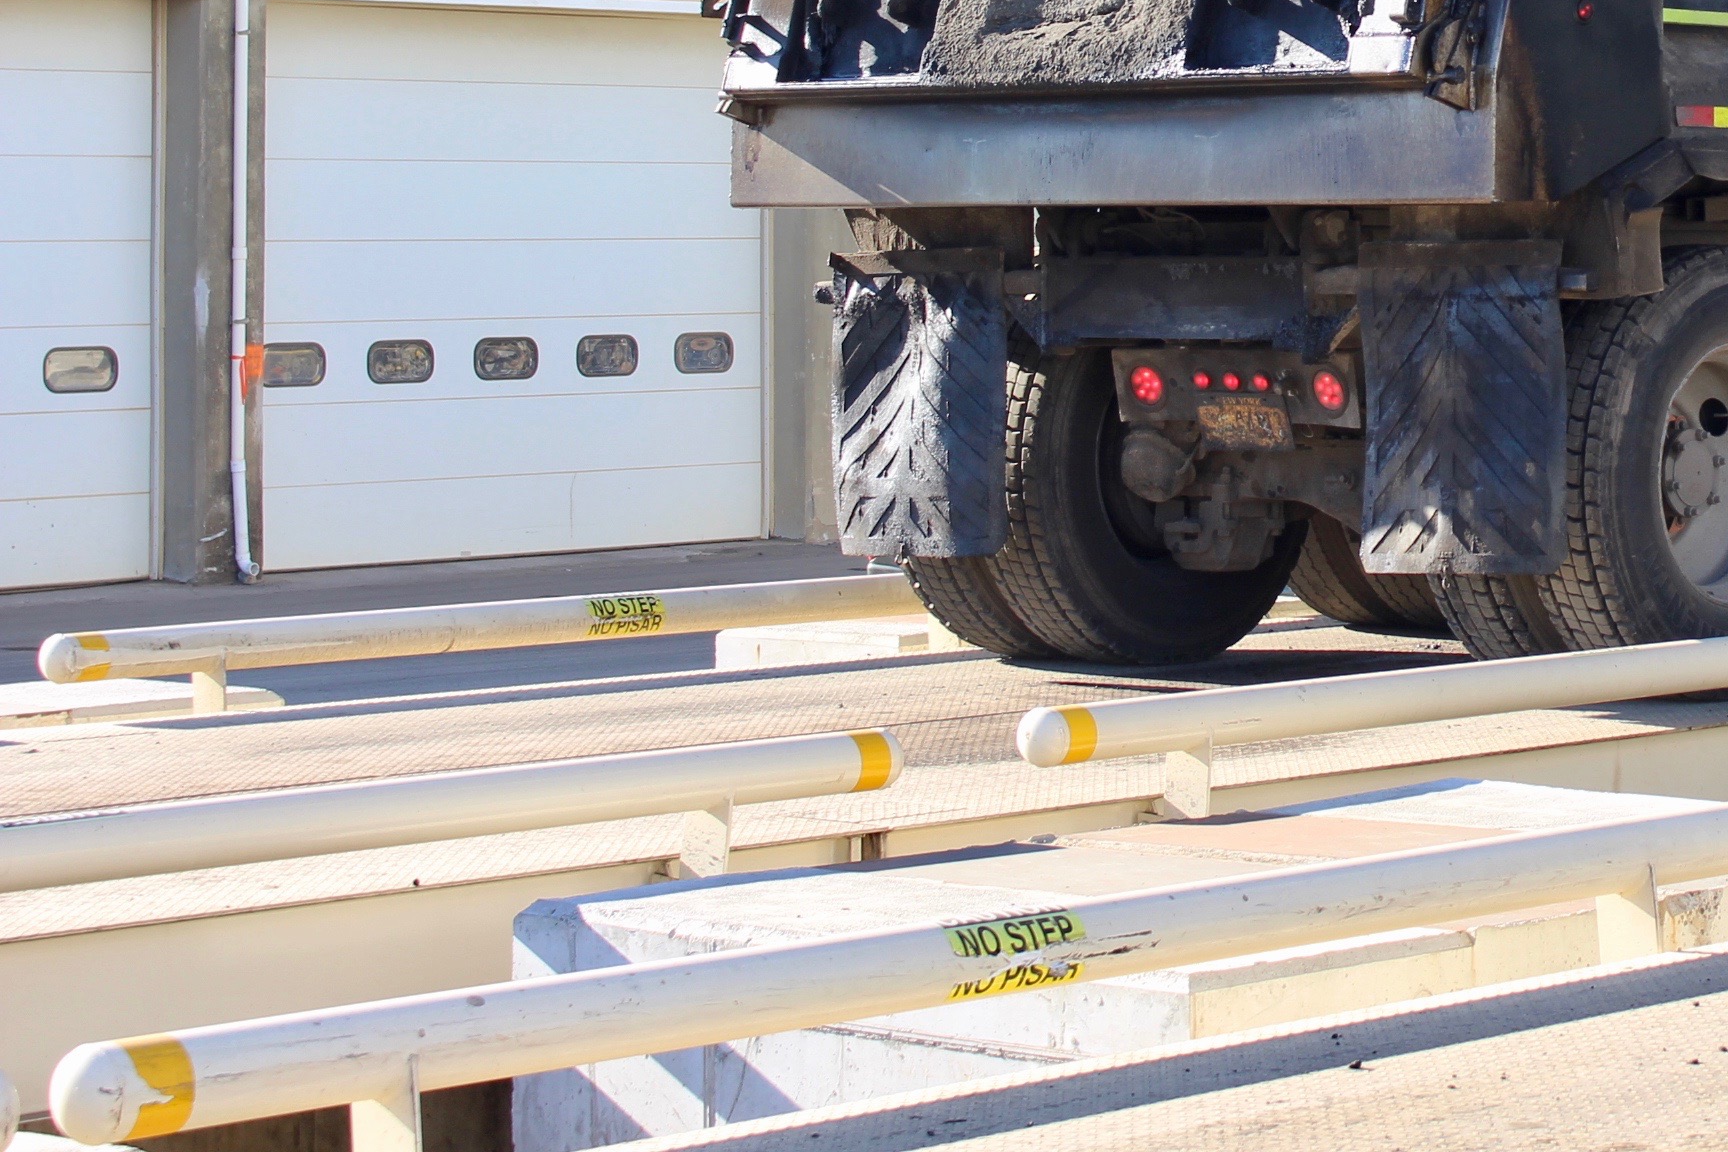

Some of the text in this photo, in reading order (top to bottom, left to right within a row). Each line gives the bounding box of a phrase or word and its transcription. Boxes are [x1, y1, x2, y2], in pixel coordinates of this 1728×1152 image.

[590, 599, 616, 617] NO
[617, 596, 657, 615] STEP
[614, 614, 663, 634] PISAR
[955, 925, 1001, 957] NO
[1003, 914, 1074, 953] STEP
